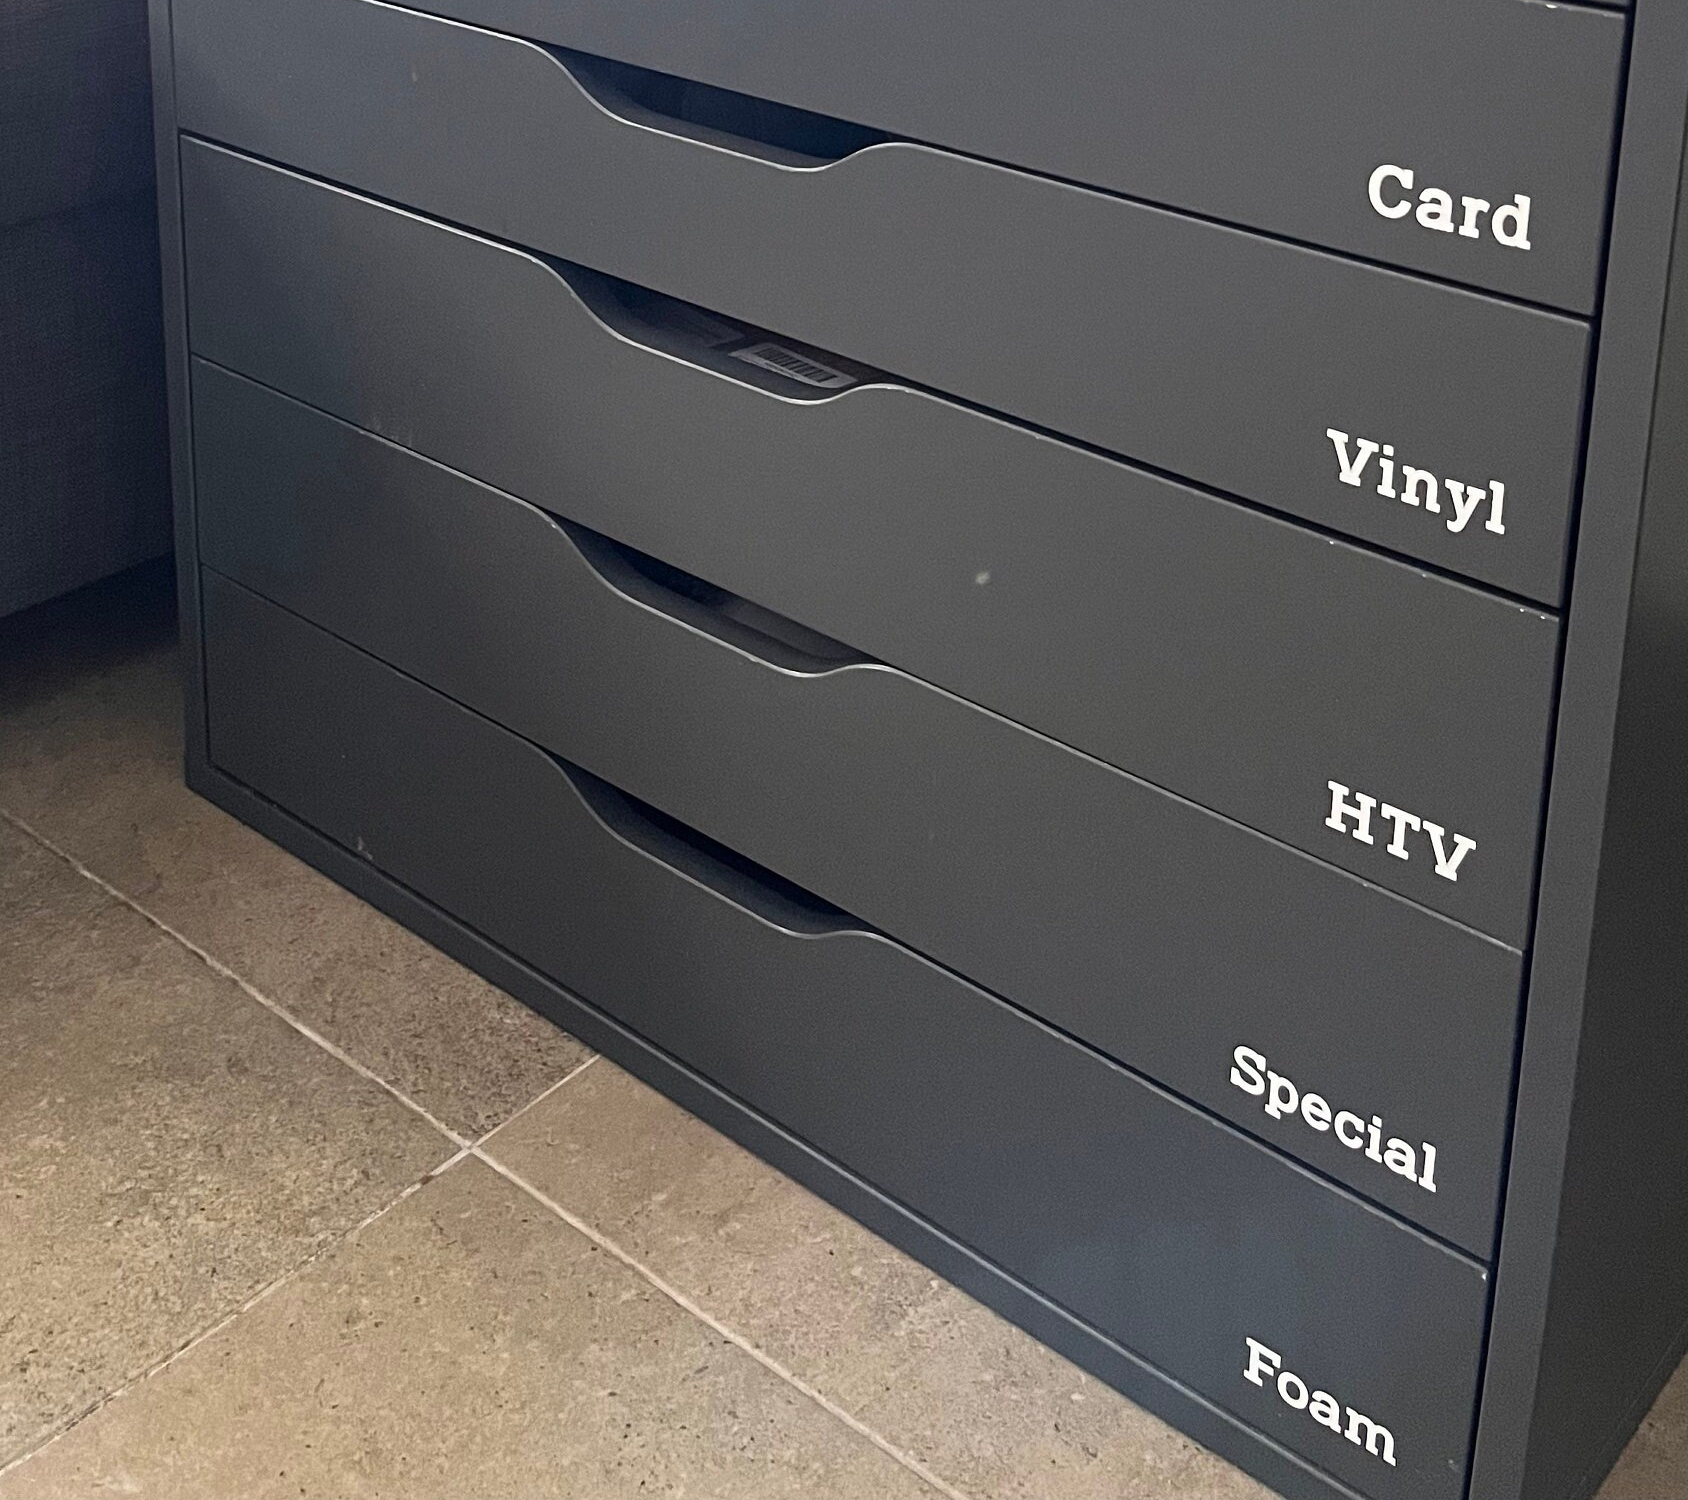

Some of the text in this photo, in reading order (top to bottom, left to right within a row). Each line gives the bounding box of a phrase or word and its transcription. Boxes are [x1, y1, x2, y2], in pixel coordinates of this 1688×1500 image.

[1367, 164, 1532, 251] Card
[1325, 427, 1507, 535] Vinyl
[1325, 779, 1478, 883] HTV
[1229, 1045, 1438, 1194] Special
[1242, 1336, 1397, 1467] Foam
